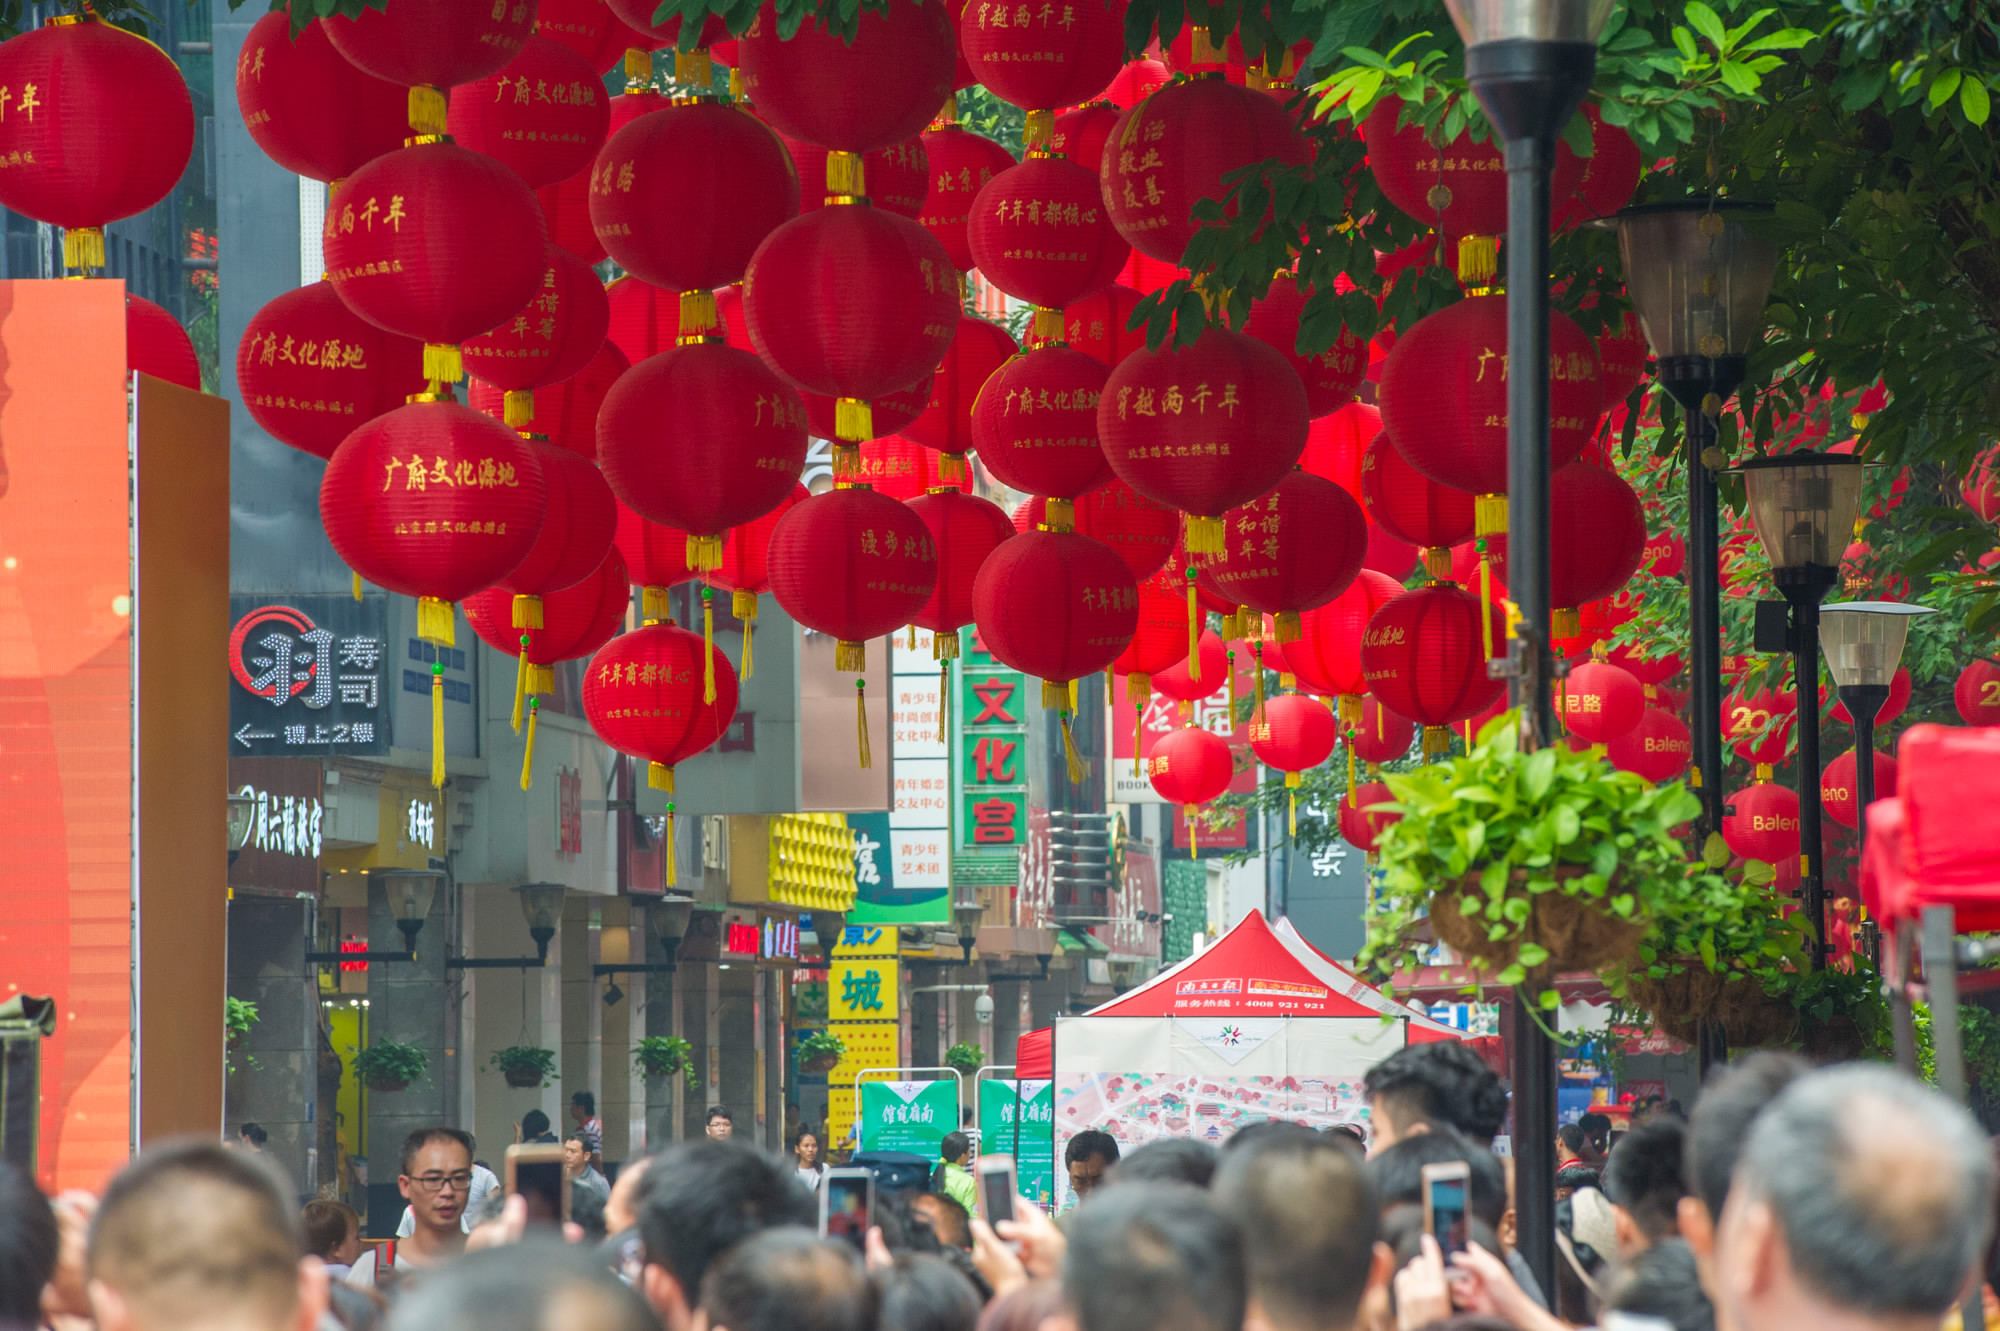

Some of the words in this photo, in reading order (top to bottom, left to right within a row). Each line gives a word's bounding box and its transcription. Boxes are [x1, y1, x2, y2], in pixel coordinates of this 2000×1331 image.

[1416, 158, 1509, 172] 北京路文化旅
[247, 331, 368, 370] 广府文化源地
[1115, 381, 1241, 422] 穿越两千年
[383, 454, 520, 492] 广府文化源地
[338, 636, 379, 709] 寿司
